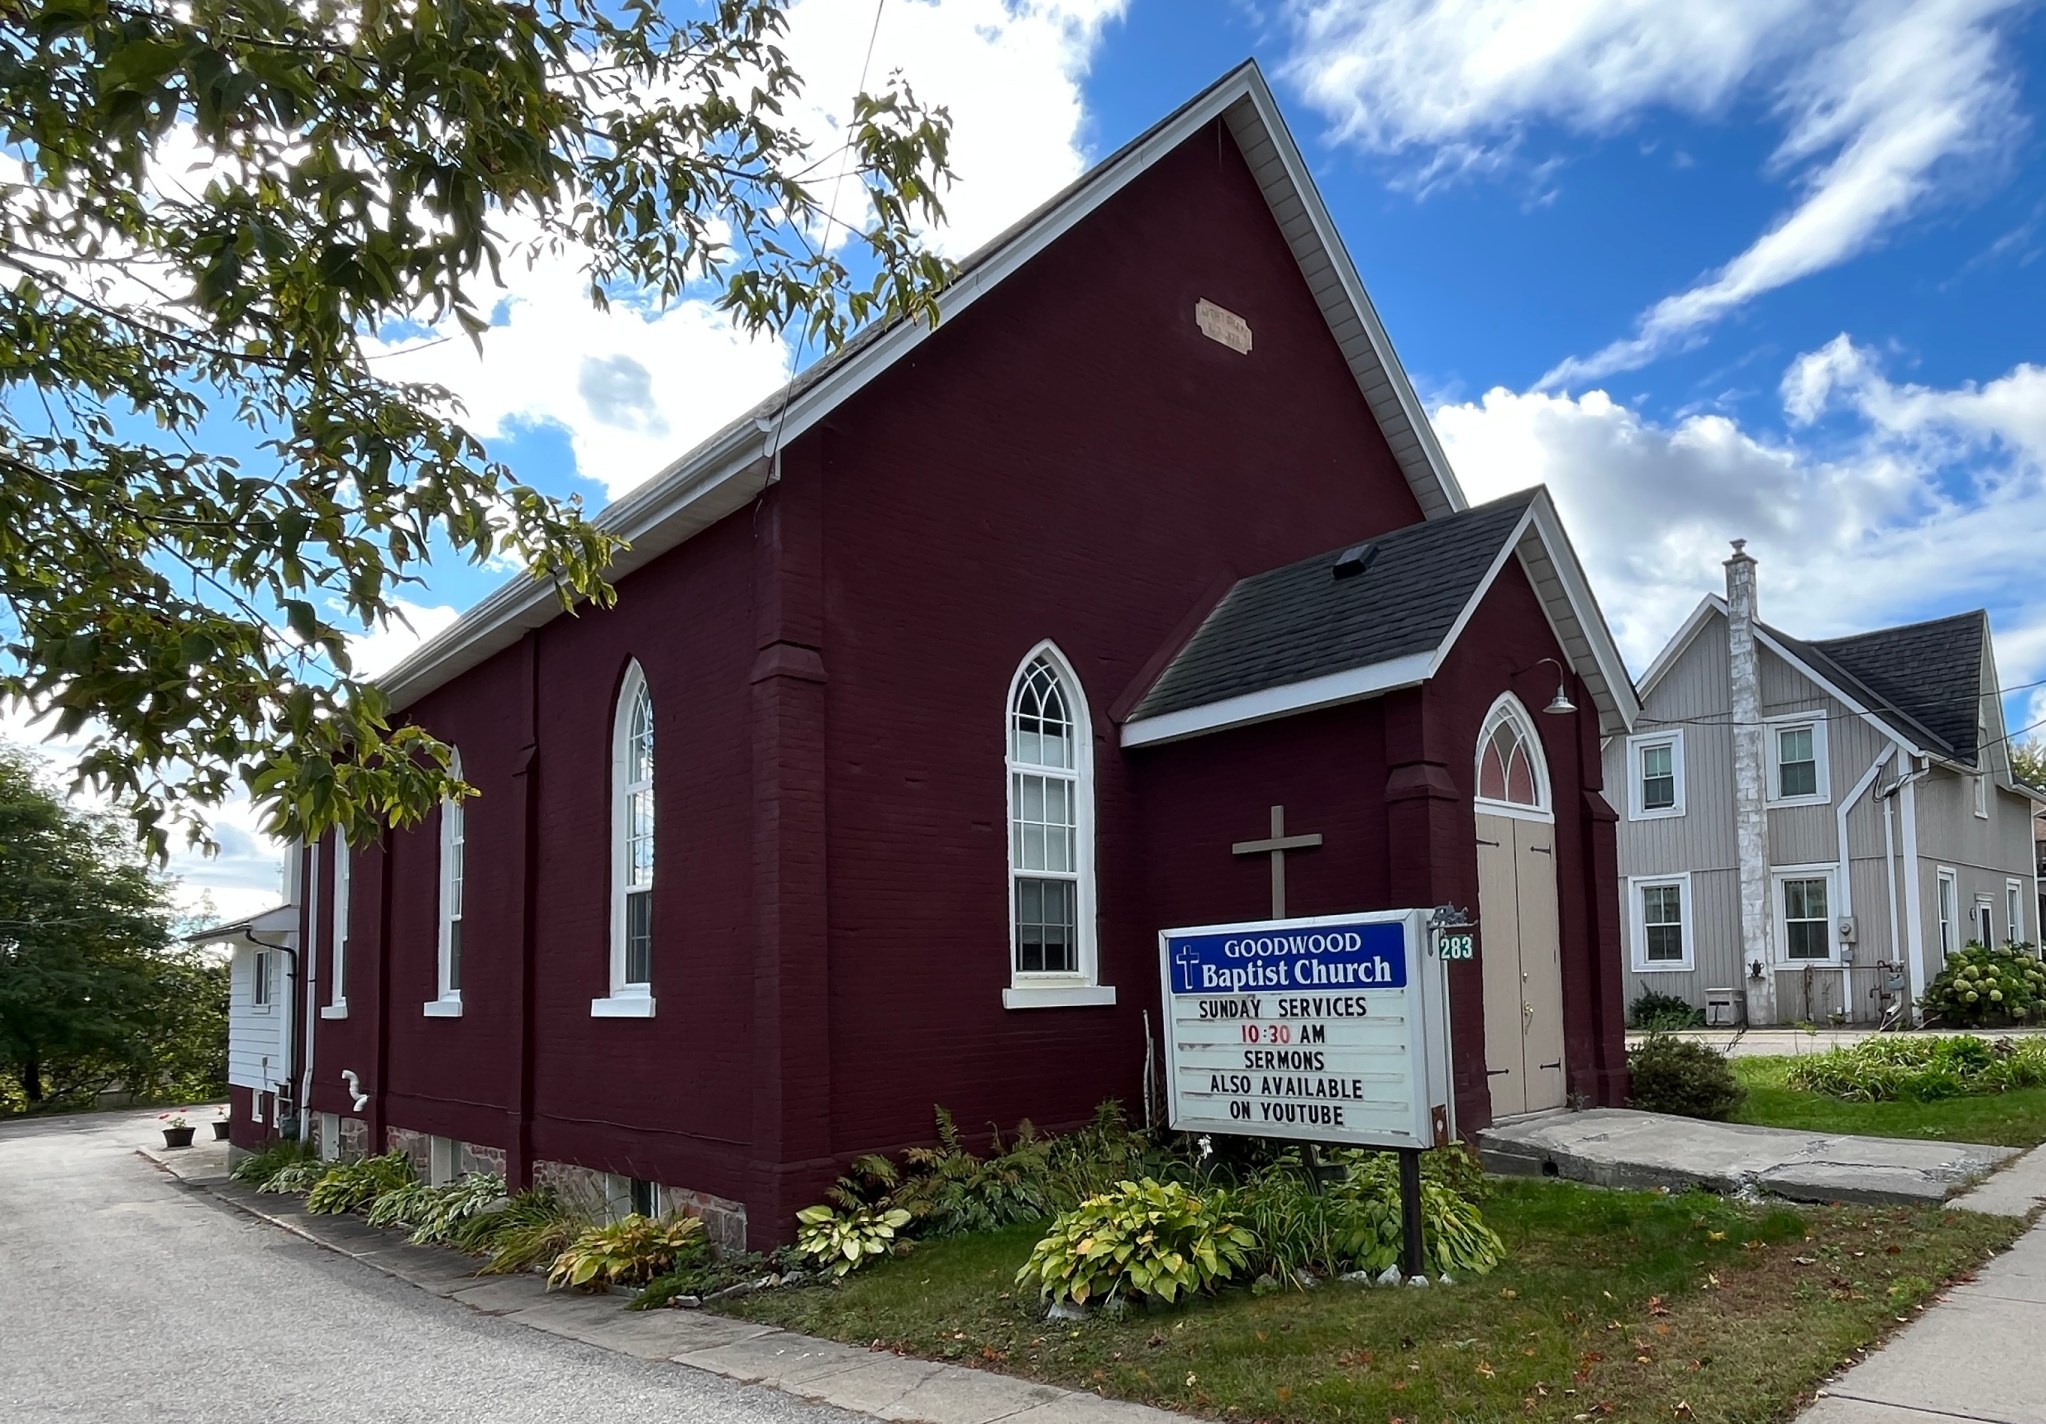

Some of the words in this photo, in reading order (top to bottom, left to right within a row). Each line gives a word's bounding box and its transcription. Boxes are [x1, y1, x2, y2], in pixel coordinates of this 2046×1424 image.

[1224, 932, 1361, 958] GOODWOOD
[1440, 936, 1473, 959] 283
[1203, 960, 1289, 992] Baptist
[1294, 956, 1392, 984] Church
[1199, 999, 1261, 1019] SUNDAY
[1278, 996, 1367, 1017] SERVICES
[1241, 1024, 1291, 1044] 10:30
[1300, 1024, 1325, 1044] AM
[1244, 1050, 1325, 1071] SERMONS
[1210, 1074, 1251, 1094] ALSO
[1261, 1076, 1363, 1099] AVAILABLE
[1230, 1101, 1251, 1120] ON
[1260, 1102, 1344, 1126] YOUTUBE
